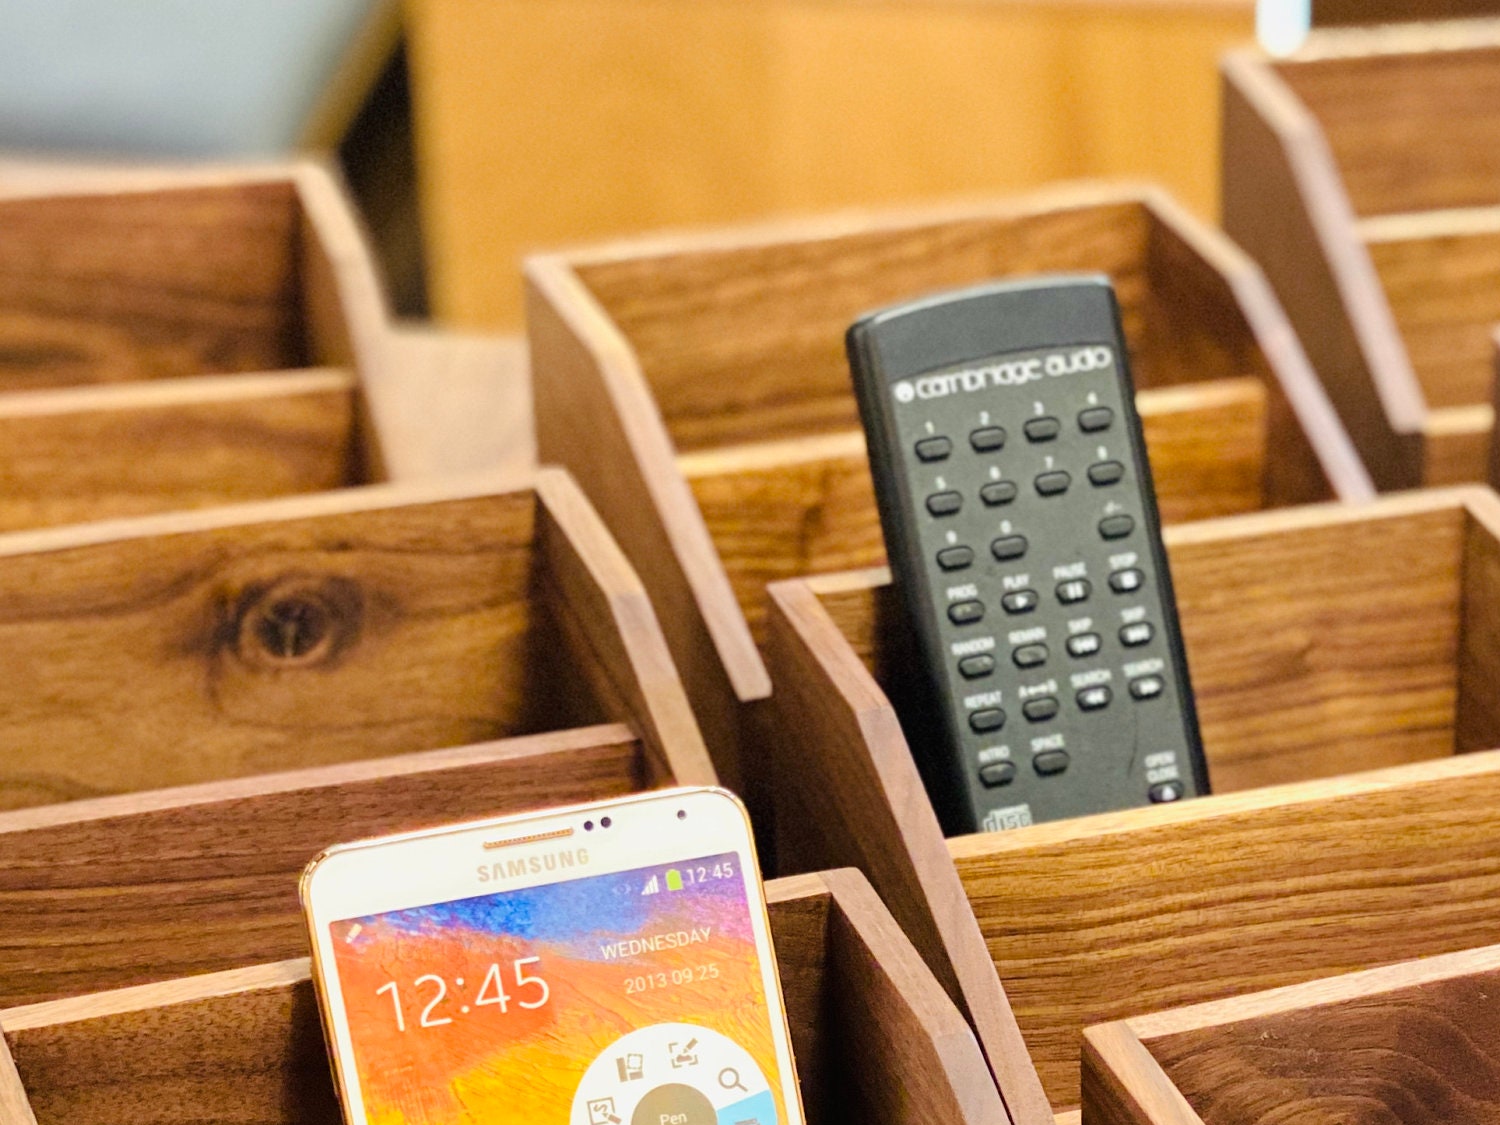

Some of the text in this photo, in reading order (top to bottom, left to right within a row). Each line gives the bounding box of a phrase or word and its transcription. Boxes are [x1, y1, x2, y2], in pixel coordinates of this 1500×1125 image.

[1045, 346, 1113, 377] audio
[1003, 574, 1030, 589] PLAY
[964, 690, 1002, 709] REPEAT
[476, 848, 589, 883] SAMSUNG
[686, 862, 734, 885] 12:45
[600, 926, 711, 960] WEDNESDAY
[375, 955, 550, 1032] 12:45
